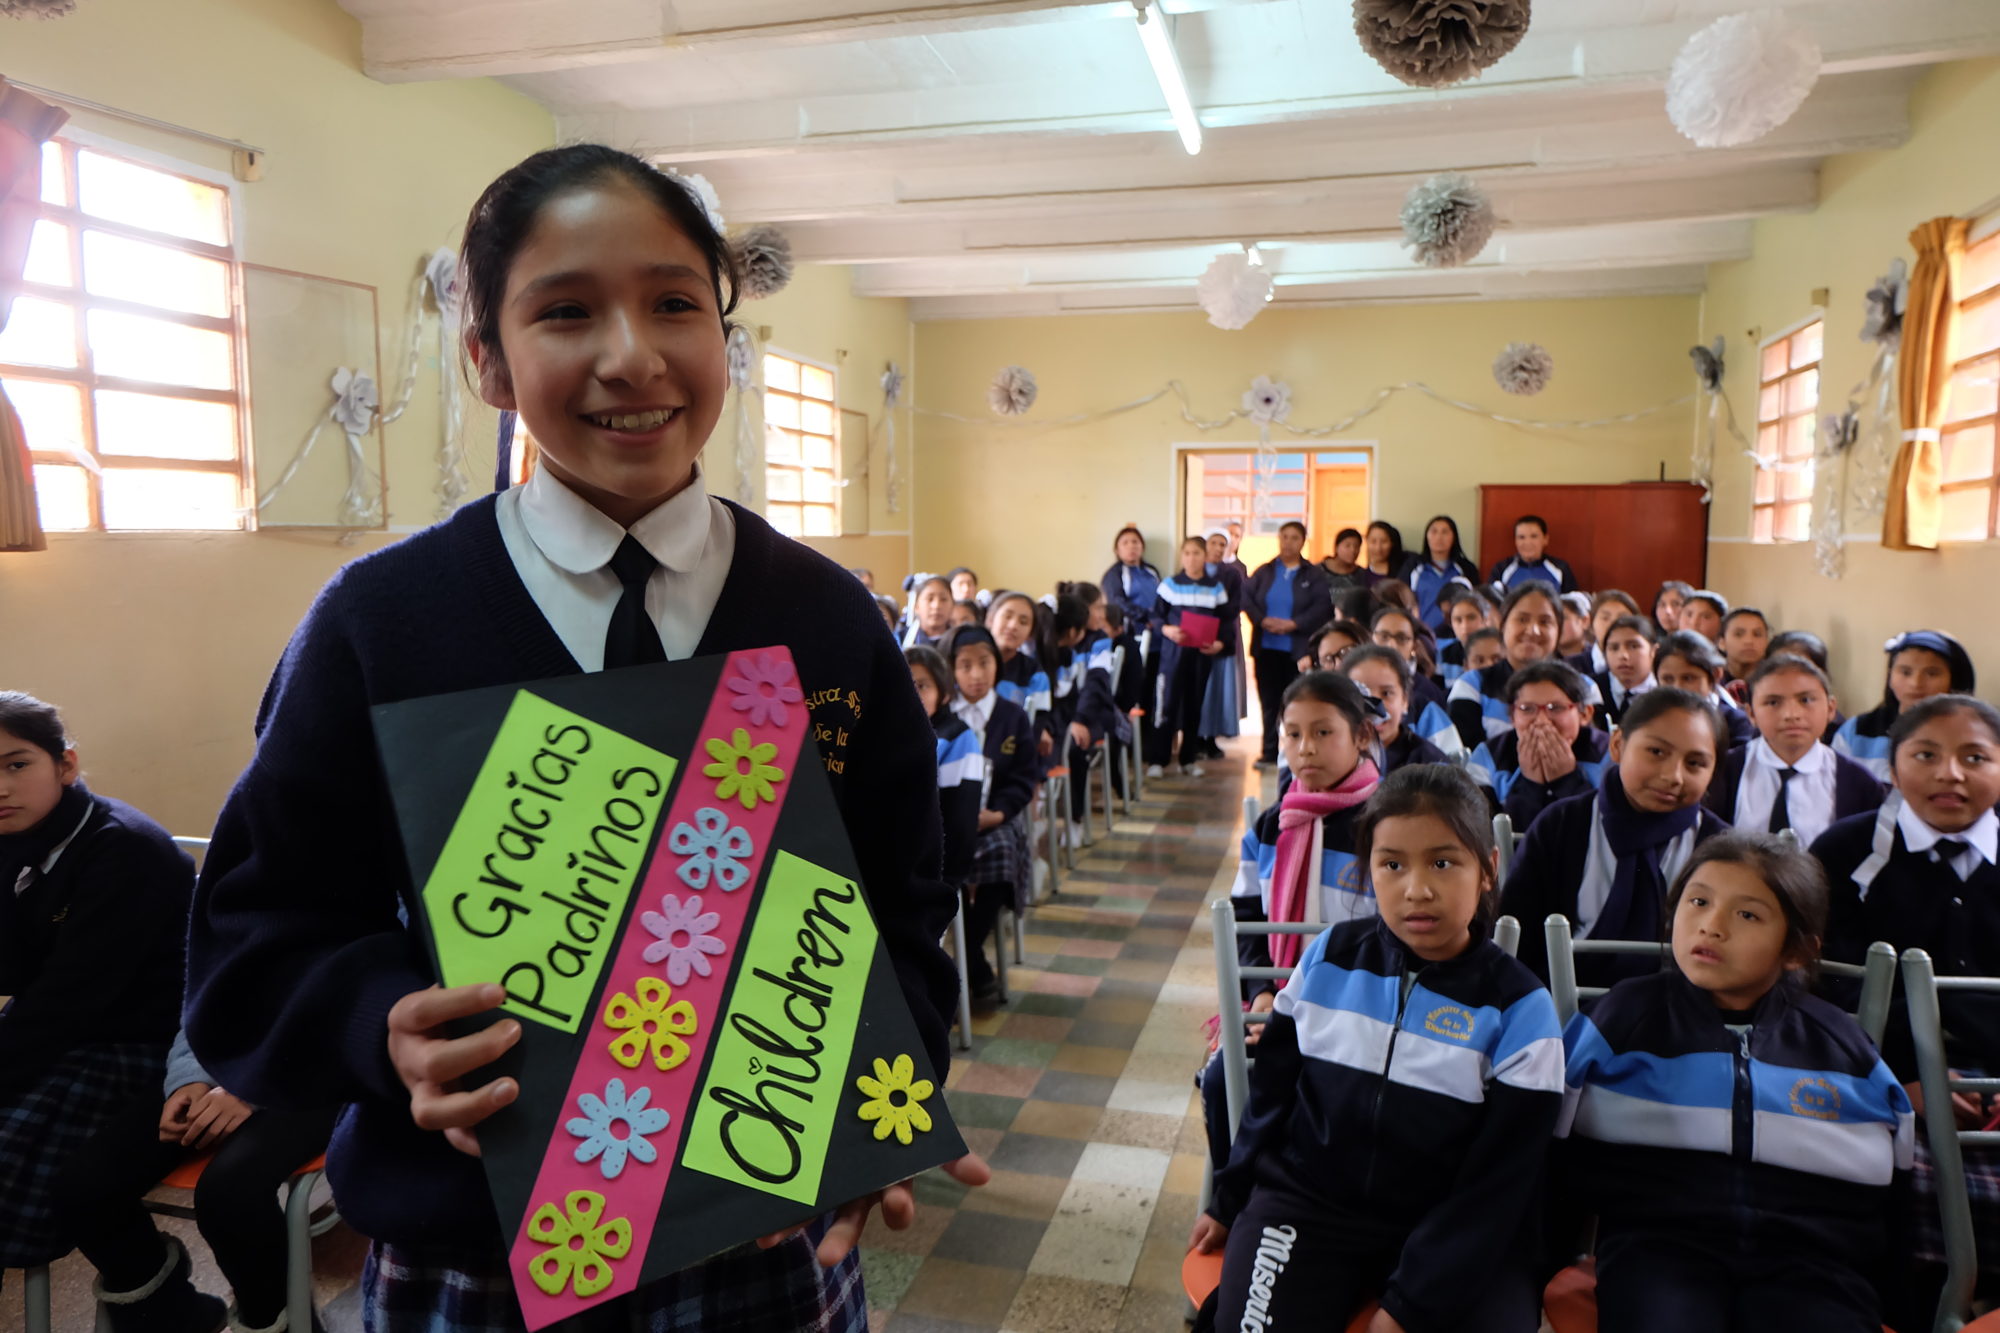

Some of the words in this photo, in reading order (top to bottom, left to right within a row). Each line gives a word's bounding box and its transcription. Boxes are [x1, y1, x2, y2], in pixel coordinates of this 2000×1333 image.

[804, 687, 842, 710] stra
[813, 722, 833, 742] de
[836, 726, 849, 746] la
[452, 722, 593, 940] Gracias
[499, 765, 662, 1025] Padrinos
[707, 882, 857, 1187] Children
[1240, 1224, 1298, 1333] Miseric
